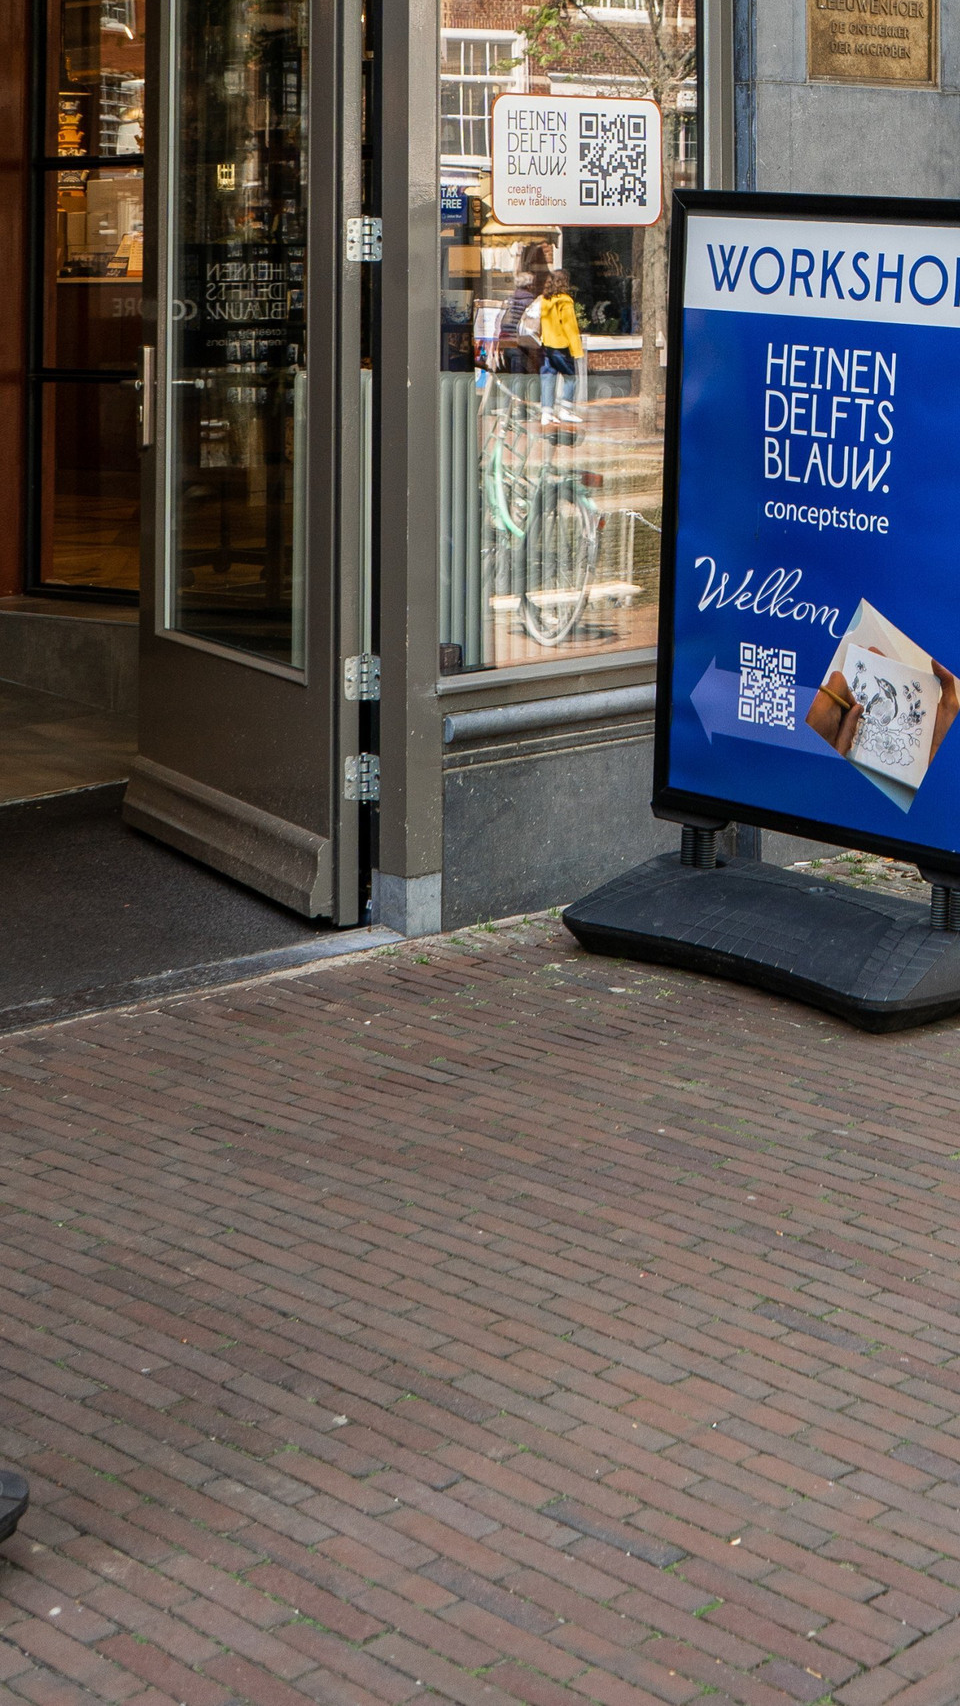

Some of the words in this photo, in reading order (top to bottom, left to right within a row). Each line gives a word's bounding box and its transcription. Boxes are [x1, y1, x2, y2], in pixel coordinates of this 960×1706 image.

[830, 21, 846, 34] DE
[849, 22, 909, 40] ONTDEKKER
[829, 41, 851, 54] DER
[855, 43, 911, 59] MICROBEN
[507, 109, 567, 132] HEINEN
[507, 132, 568, 154] DELFTS
[507, 155, 567, 176] BLAUW.
[441, 186, 458, 198] TAX
[507, 184, 542, 198] creating
[507, 198, 526, 207] new
[529, 196, 567, 207] traditions
[441, 198, 462, 209] FREE
[765, 342, 897, 396] HEINEN
[764, 390, 895, 445] DELFTS
[764, 436, 892, 494] BLAUW.
[764, 499, 890, 534] conceptstore
[694, 556, 850, 639] Welkom
